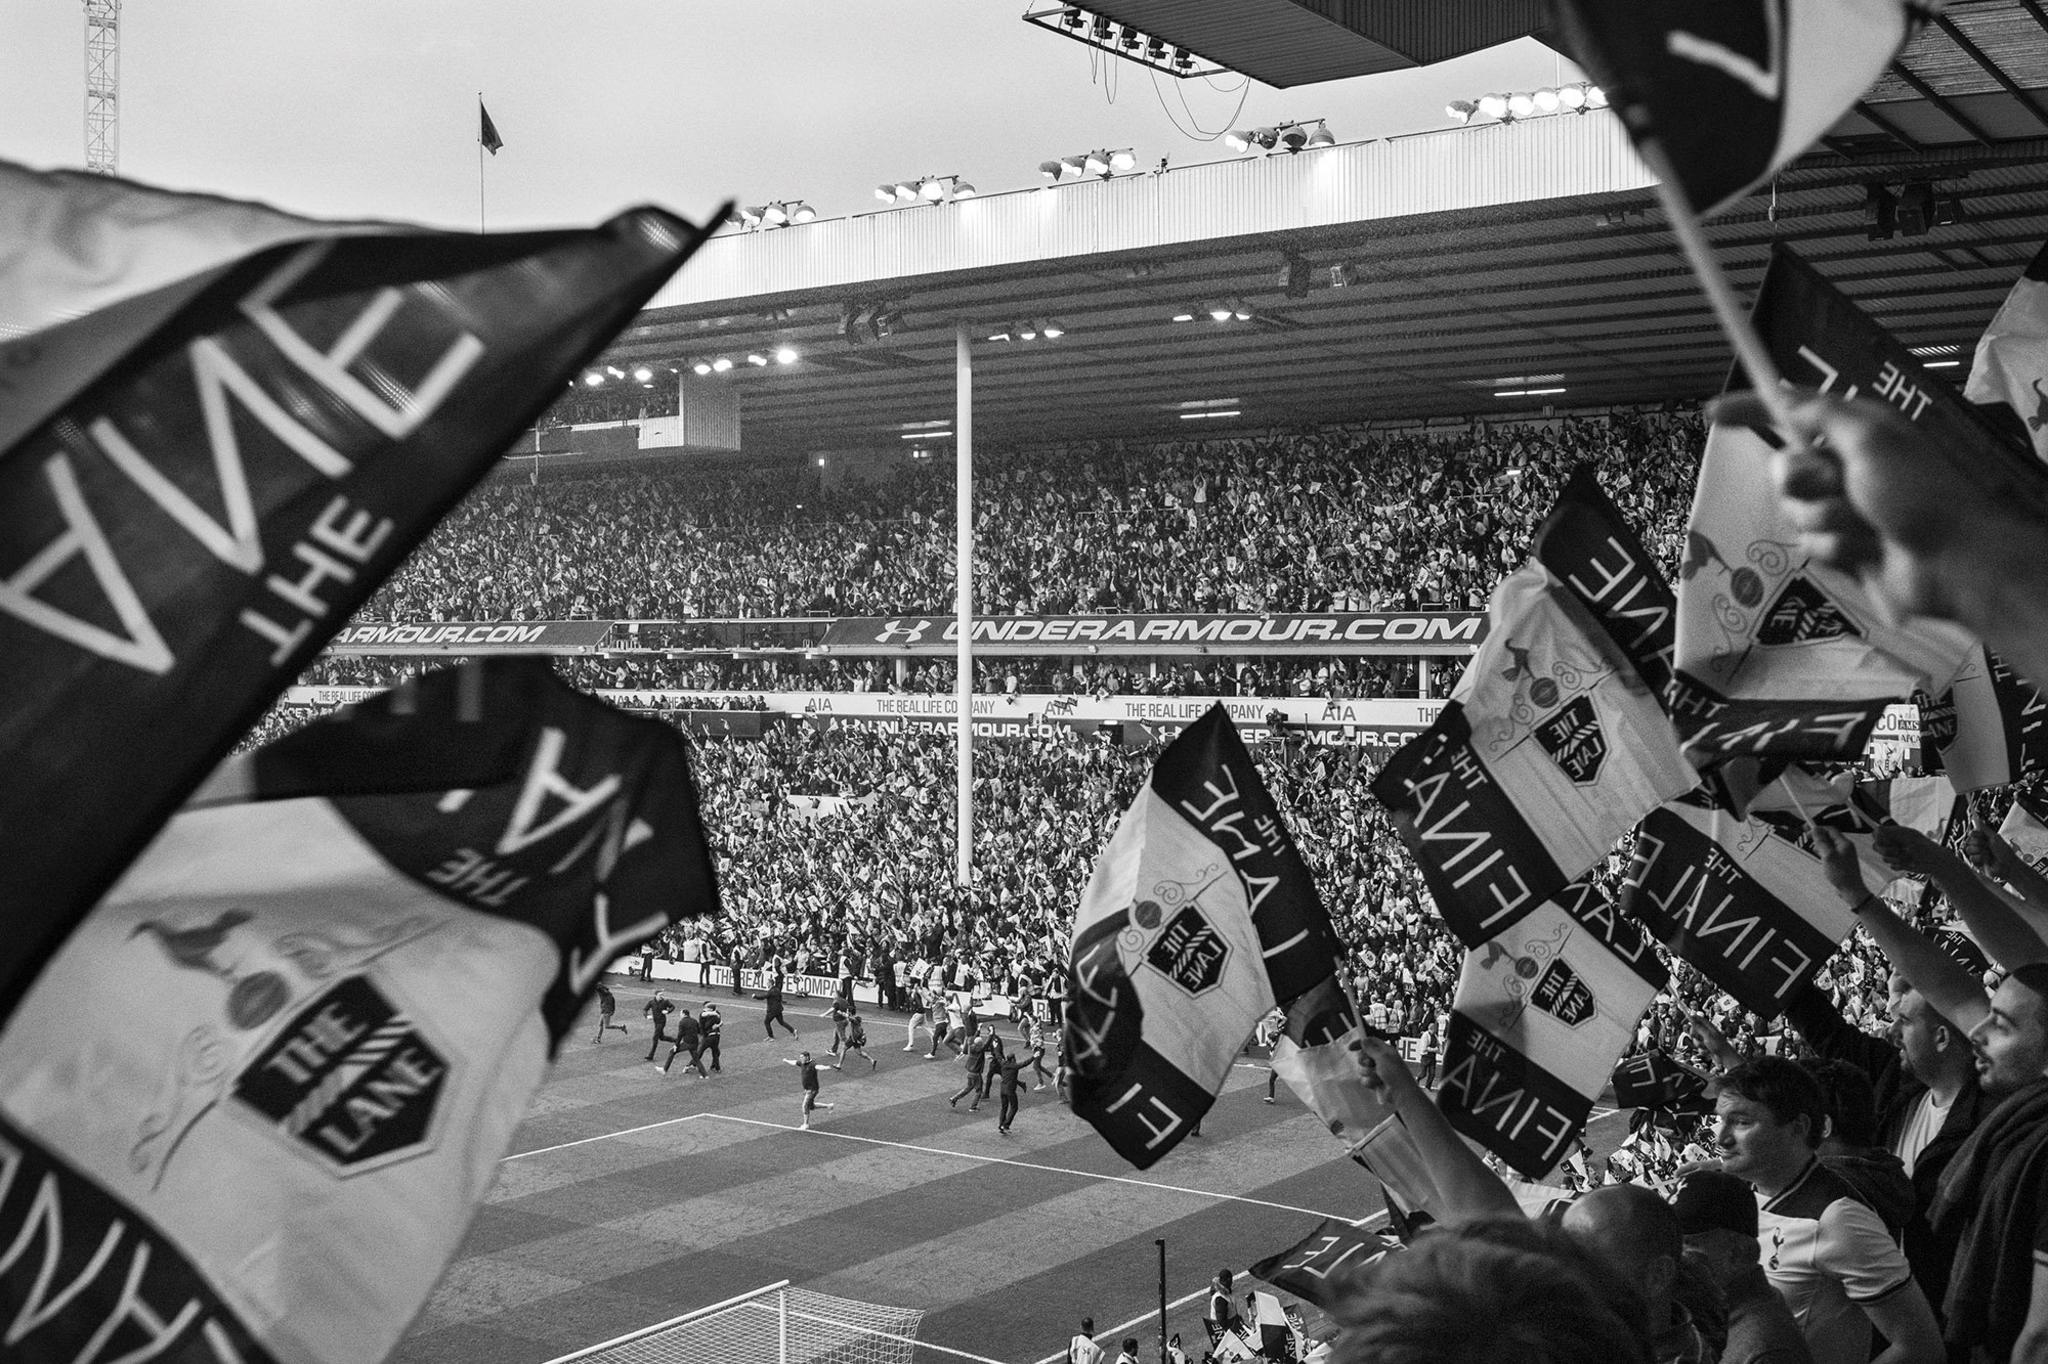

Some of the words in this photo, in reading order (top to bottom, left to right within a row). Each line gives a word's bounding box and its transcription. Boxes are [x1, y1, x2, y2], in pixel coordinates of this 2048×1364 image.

[335, 625, 548, 644] ARMOUR.COM
[808, 698, 833, 711] AIA
[877, 699, 895, 712] THE
[921, 700, 941, 713] LIFE
[943, 700, 995, 714] COANY
[1125, 703, 1147, 717] THE
[1148, 703, 1178, 718] REAL
[1179, 704, 1203, 719] LIFE
[1321, 705, 1357, 721] AIA
[262, 1001, 370, 1085] THE
[320, 1046, 442, 1154] LANE
